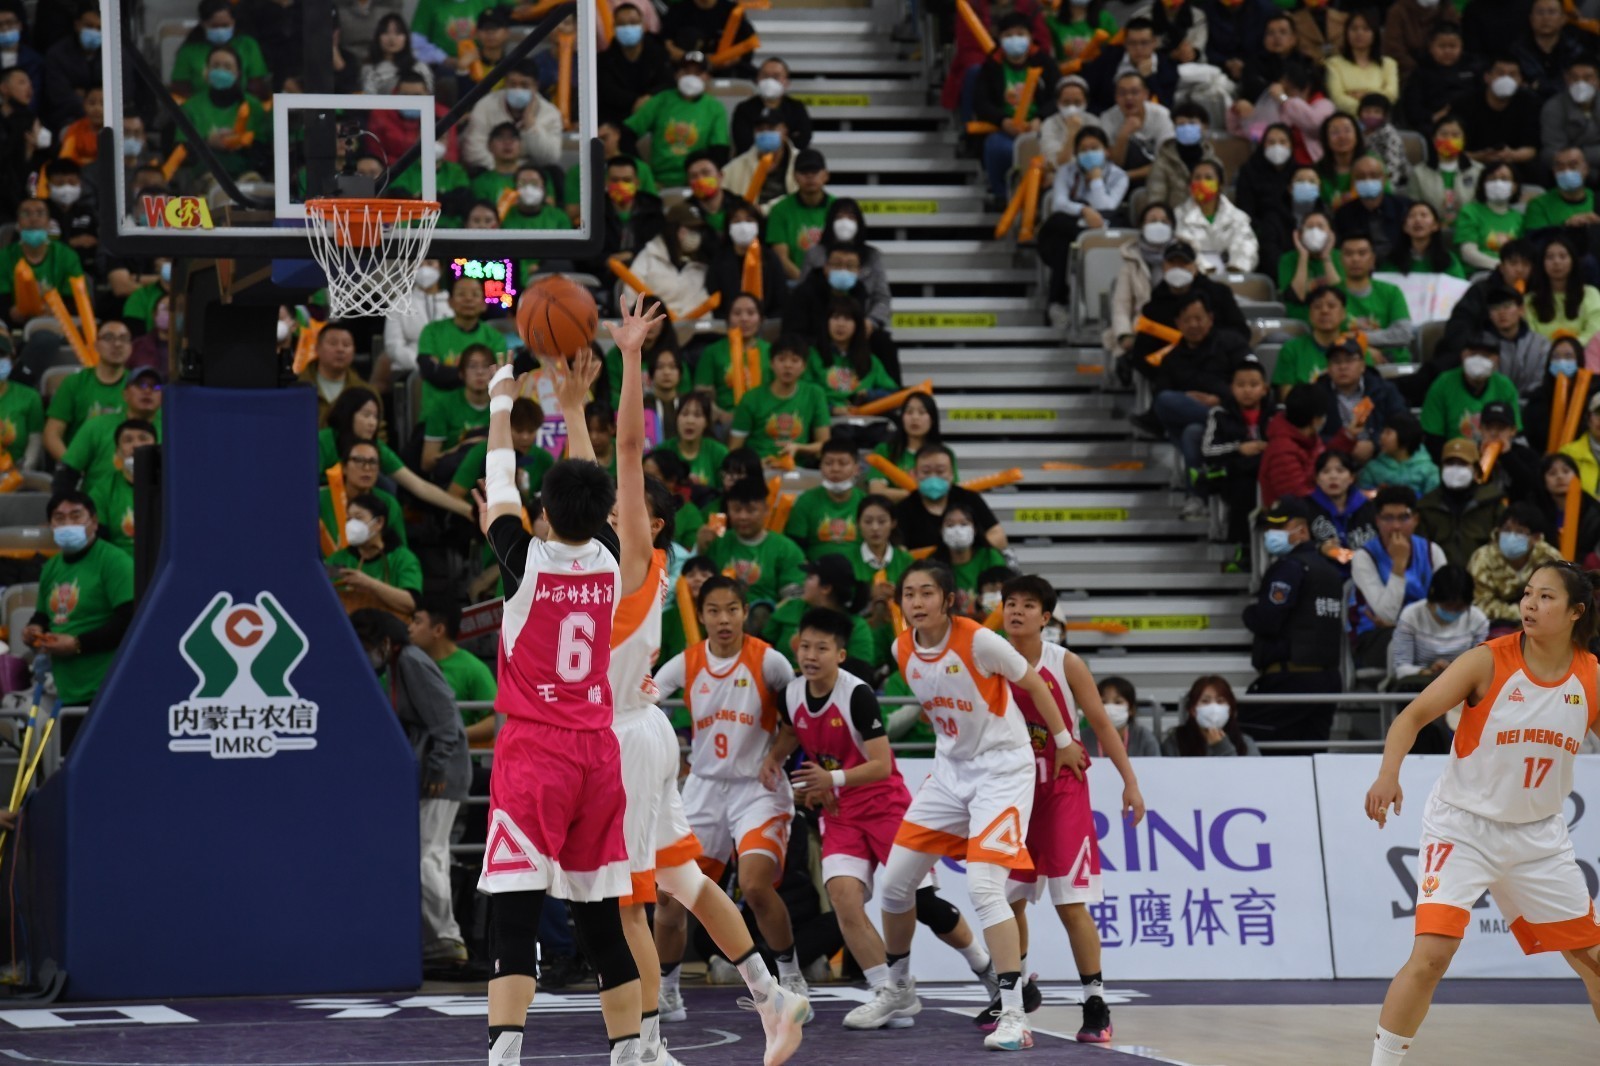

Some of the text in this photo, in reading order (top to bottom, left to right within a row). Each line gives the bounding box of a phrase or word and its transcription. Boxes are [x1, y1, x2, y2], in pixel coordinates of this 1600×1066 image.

[556, 612, 595, 683] 6
[173, 705, 314, 731] 内蒙古农信
[738, 713, 754, 726] GU
[215, 735, 273, 754] IMRC
[714, 733, 728, 759] 9
[1496, 728, 1580, 755] NEI MENG GU
[1523, 757, 1555, 789] 17
[1423, 842, 1456, 874] 17
